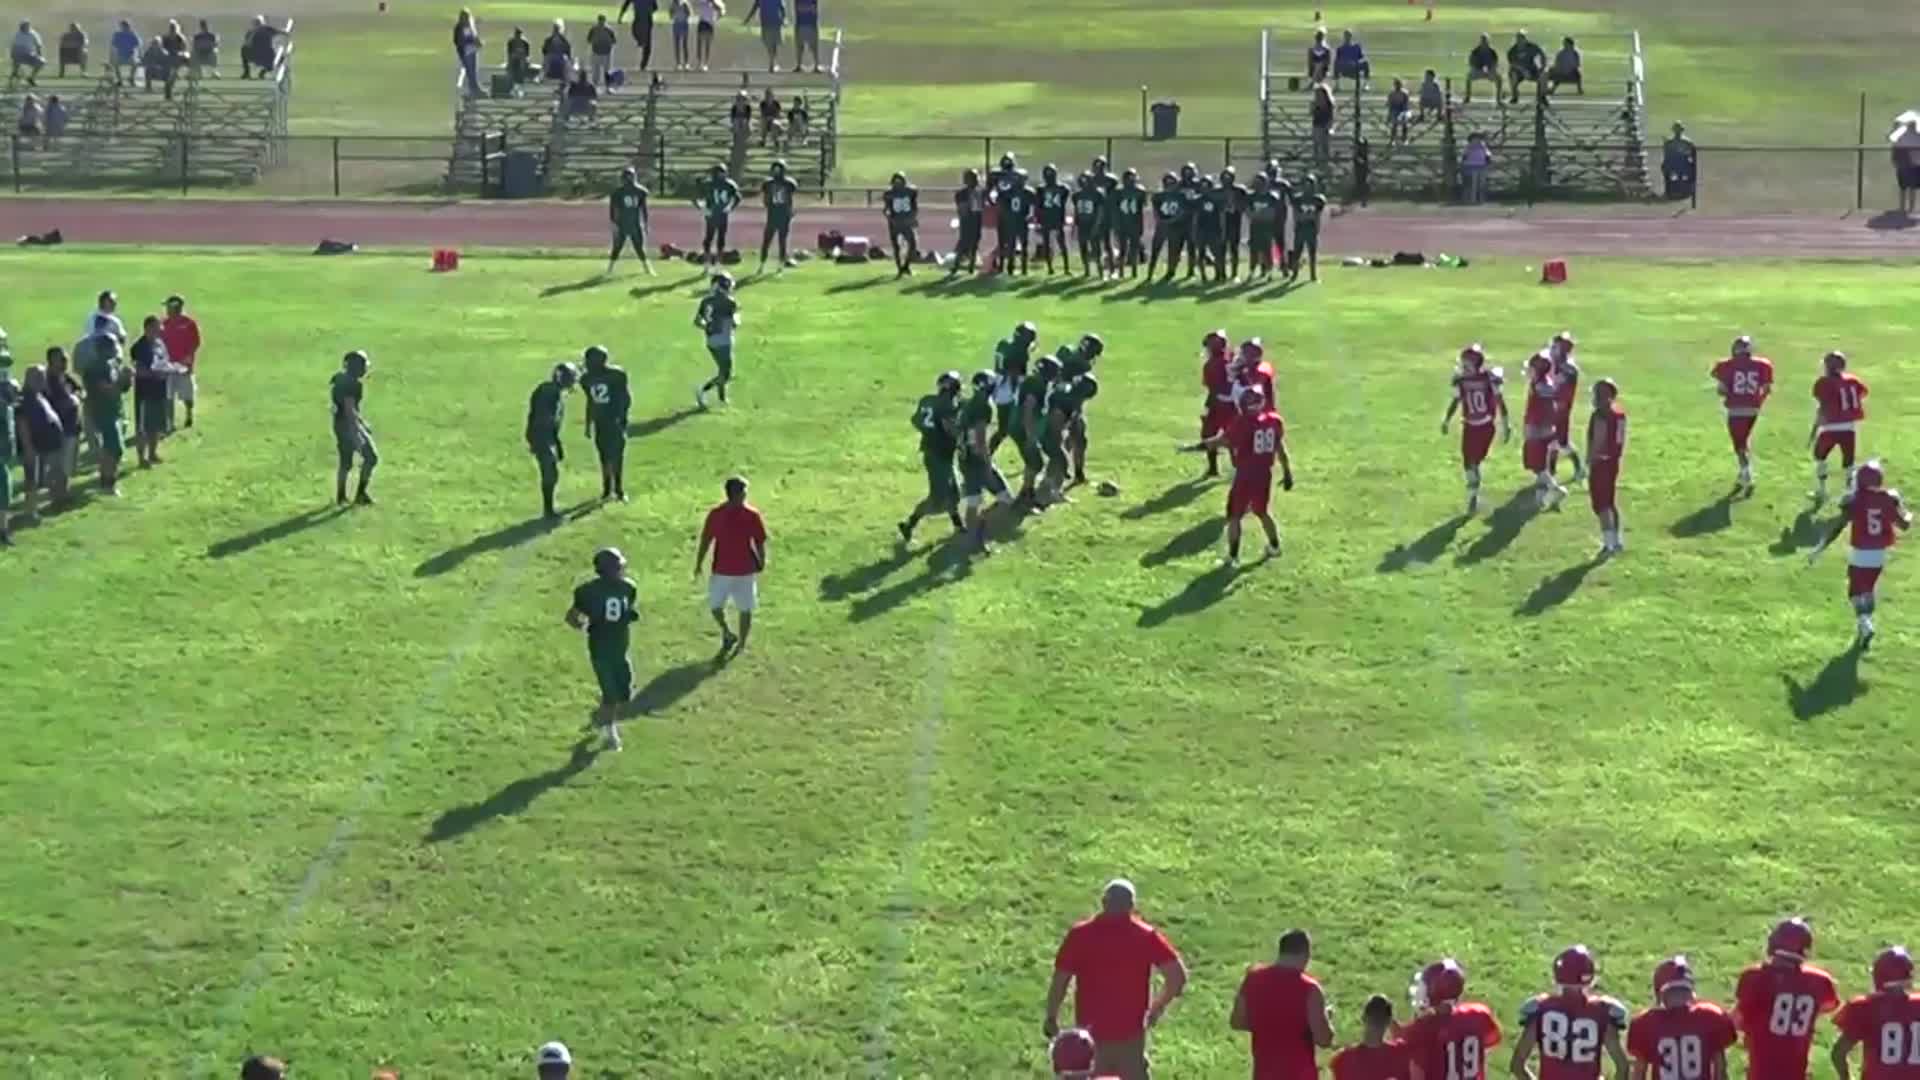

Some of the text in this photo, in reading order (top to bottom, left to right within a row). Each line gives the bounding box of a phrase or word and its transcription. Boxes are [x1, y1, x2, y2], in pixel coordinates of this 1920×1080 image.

[1466, 390, 1487, 414] 10
[1732, 370, 1760, 396] 25
[1839, 386, 1861, 412] 11
[1541, 1010, 1599, 1063] 82
[1769, 992, 1816, 1037] 83
[1446, 1034, 1481, 1080] 19
[1657, 1034, 1703, 1080] 38
[1880, 1021, 1920, 1066] 81
